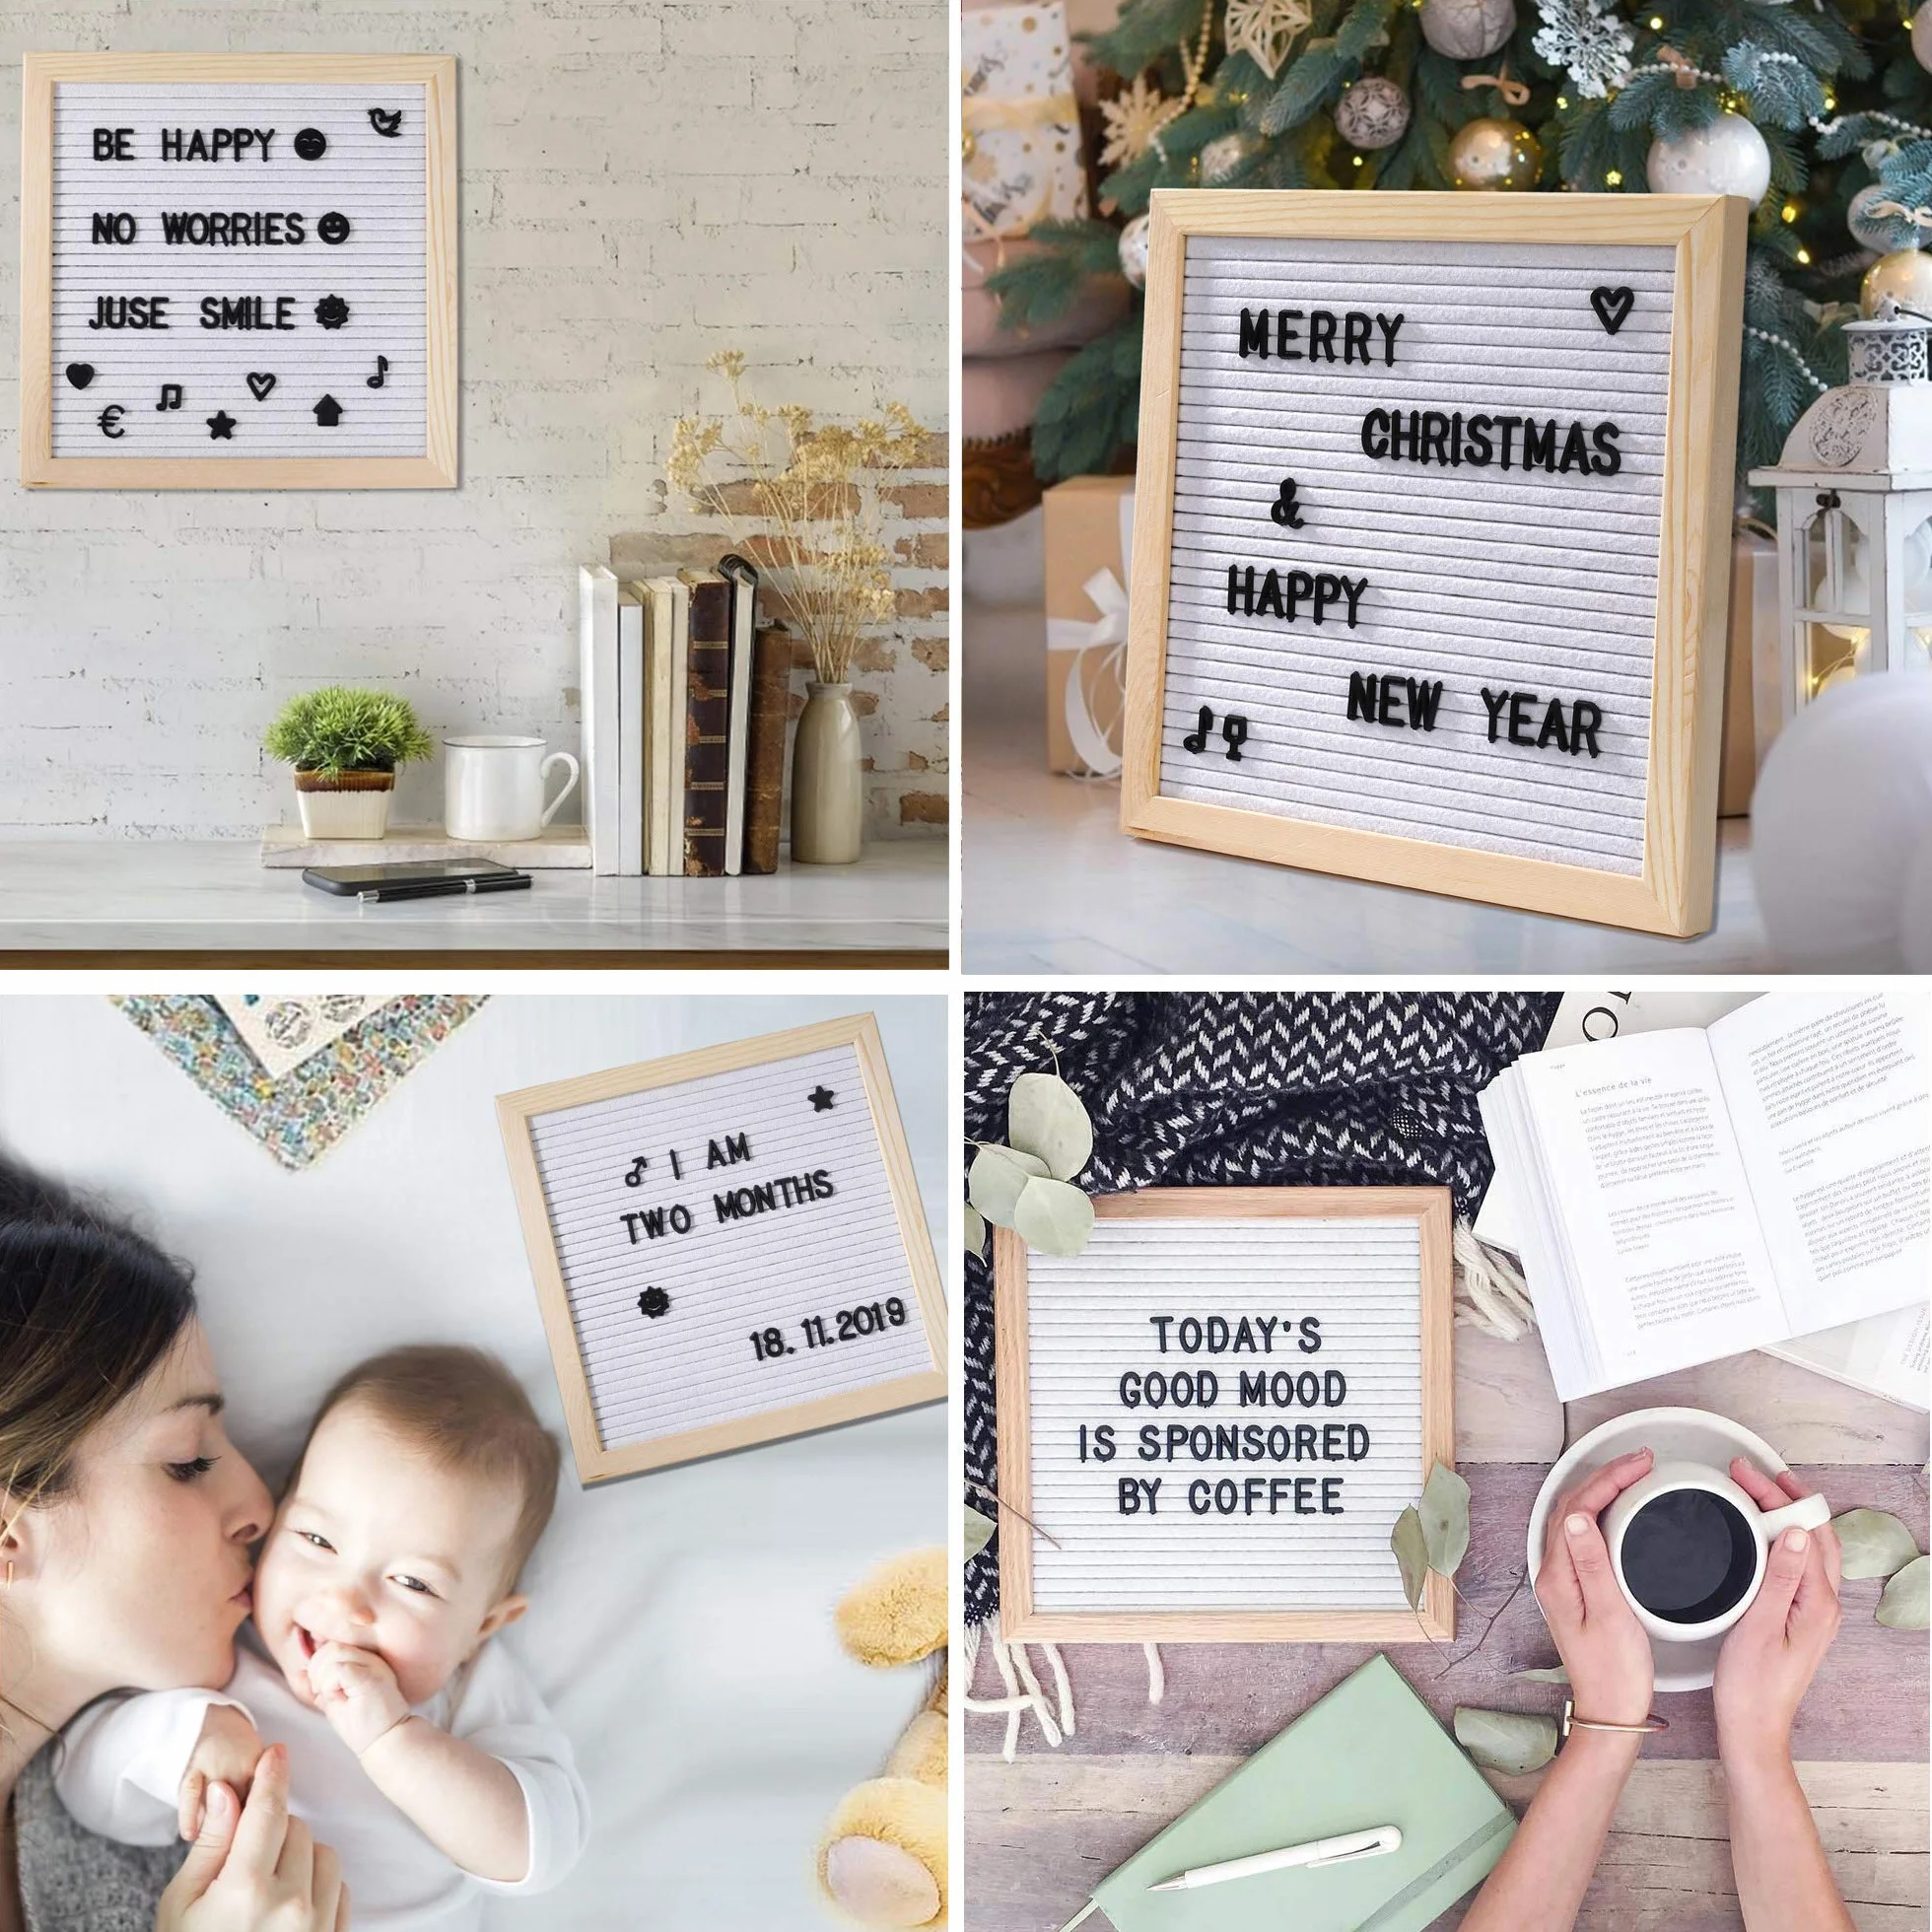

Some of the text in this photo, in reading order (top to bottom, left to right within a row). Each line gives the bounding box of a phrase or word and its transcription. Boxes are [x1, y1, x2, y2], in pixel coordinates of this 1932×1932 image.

[94, 128, 275, 162] BE HAPPY
[93, 212, 305, 246] NO WORRIES
[89, 297, 295, 330] JUSE SMILE
[1239, 308, 1406, 367] MERRY
[1361, 408, 1626, 476] CHRISTMAS
[1271, 478, 1308, 529] &
[1222, 564, 1372, 629] HAPPY
[1346, 671, 1607, 758] NEW YEAR
[1575, 1076, 1653, 1098] L'essence de la vie
[670, 1133, 751, 1180] I AM
[620, 1170, 833, 1244] TWO MONTHS
[1150, 1316, 1321, 1353] TODAY'S
[1120, 1370, 1346, 1409] GOOD MOOD
[1078, 1424, 1369, 1463] IS SPONSORED
[1118, 1478, 1344, 1515] BY COFFEE
